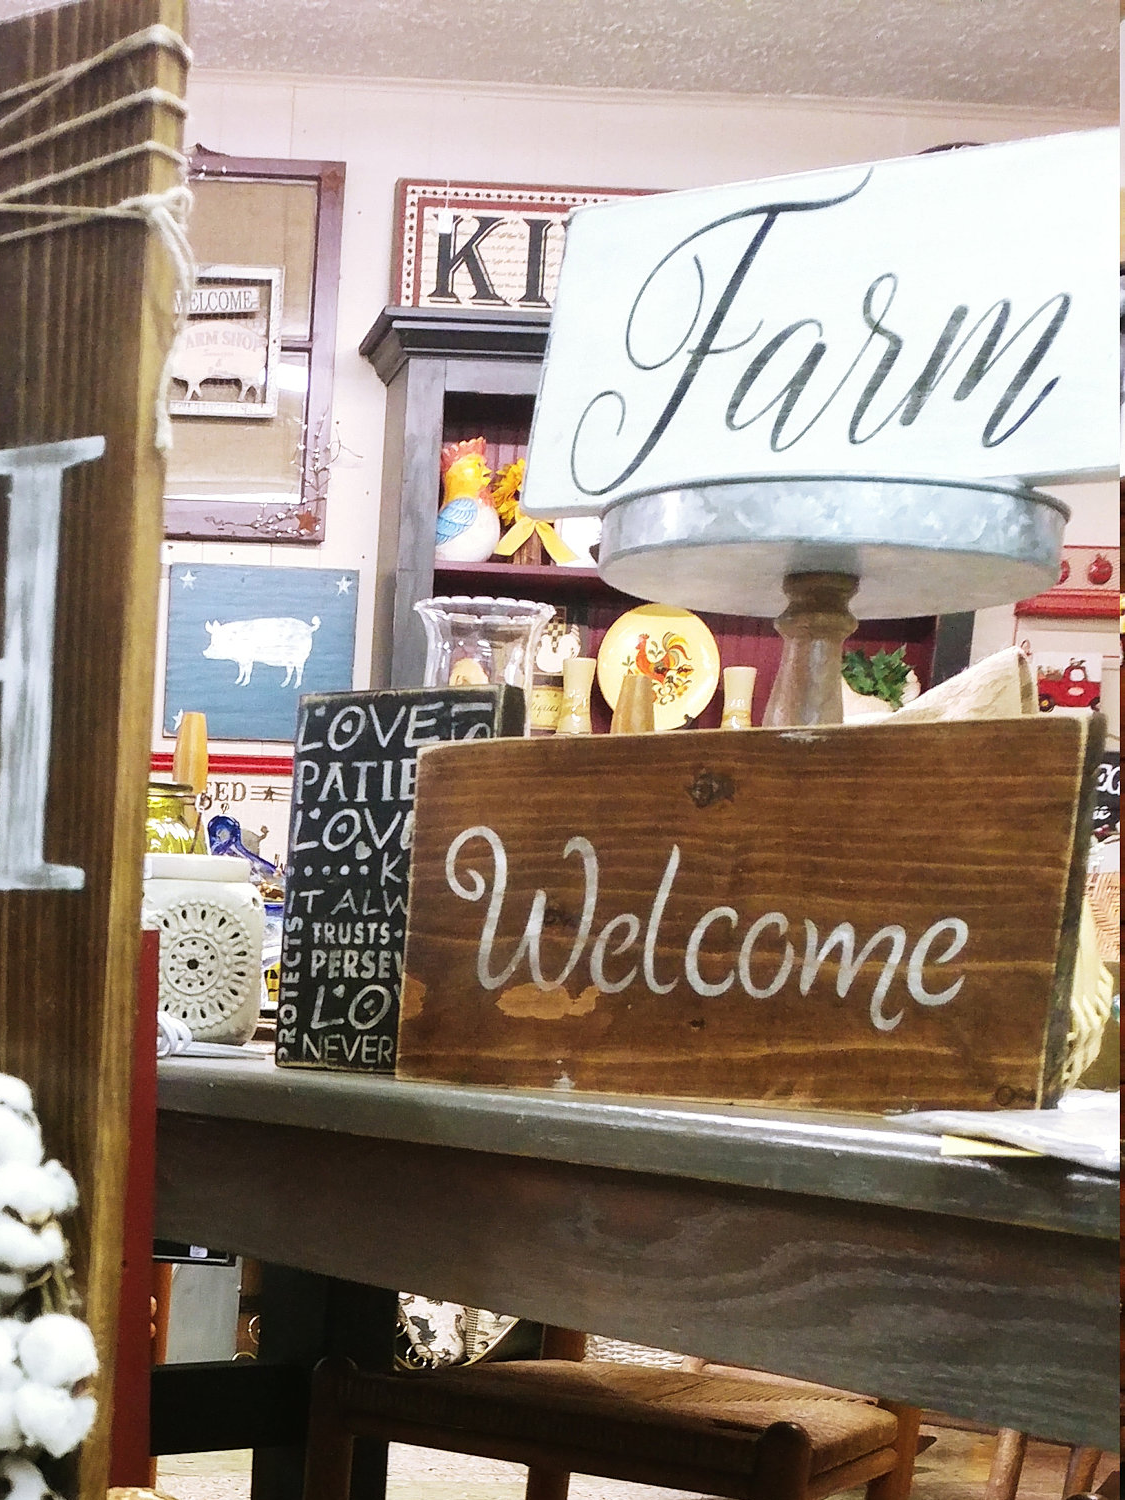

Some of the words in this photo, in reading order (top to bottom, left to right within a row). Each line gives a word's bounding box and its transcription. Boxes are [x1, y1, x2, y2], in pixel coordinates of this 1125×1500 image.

[427, 213, 571, 309] KI
[186, 330, 218, 350] ARM
[571, 166, 1072, 496] Farm
[295, 701, 444, 753] LOVE
[287, 890, 325, 914] IT
[311, 922, 391, 946] TRUSTS
[446, 826, 969, 1031] Welcome
[278, 915, 304, 1061] PROTECTS
[310, 984, 402, 1030] LO
[302, 1032, 395, 1065] NEVER
